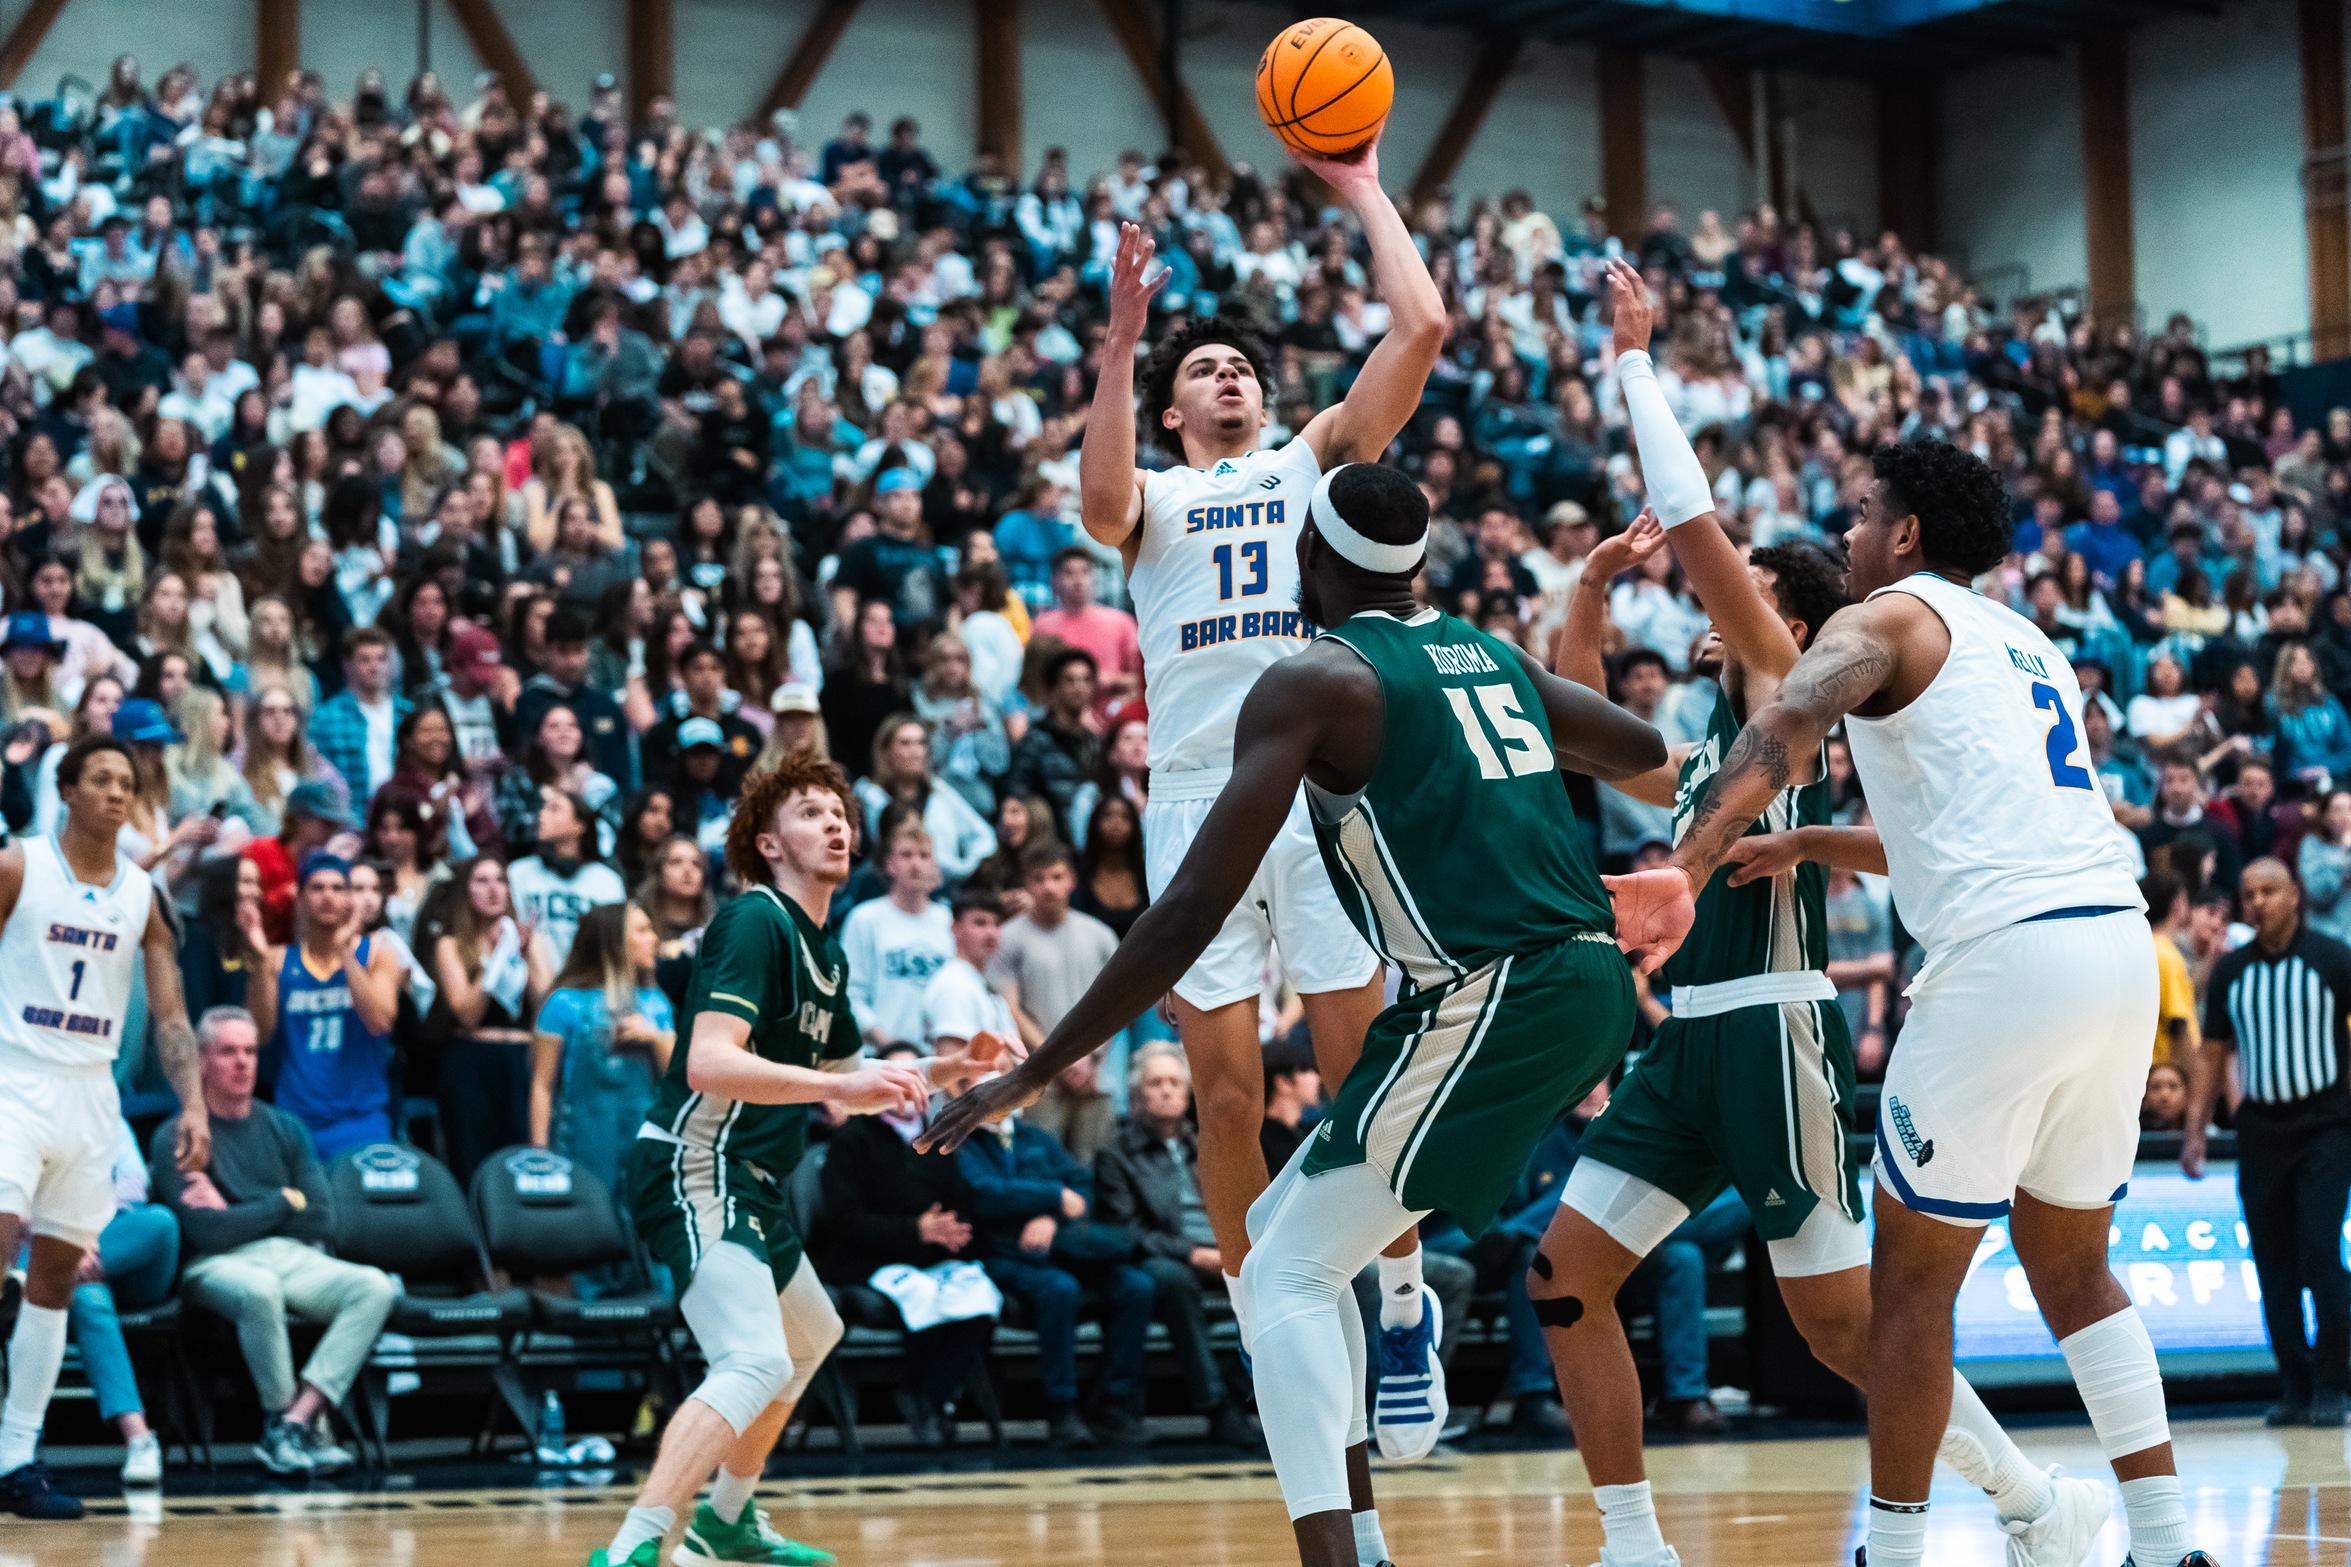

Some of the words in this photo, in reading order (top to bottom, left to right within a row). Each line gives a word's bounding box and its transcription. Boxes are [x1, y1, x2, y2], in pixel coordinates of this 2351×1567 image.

[1185, 498, 1287, 536] SANTA
[1211, 539, 1270, 604] 13
[1422, 642, 1500, 675] KOROMA
[2004, 641, 2051, 680] KELLY
[1442, 683, 1555, 779] 15
[2030, 678, 2096, 793] 2
[48, 922, 118, 952] SANTA
[70, 959, 86, 1001] 1
[1889, 1095, 1920, 1160] BARBARA
[1898, 1105, 1924, 1151] SANTA
